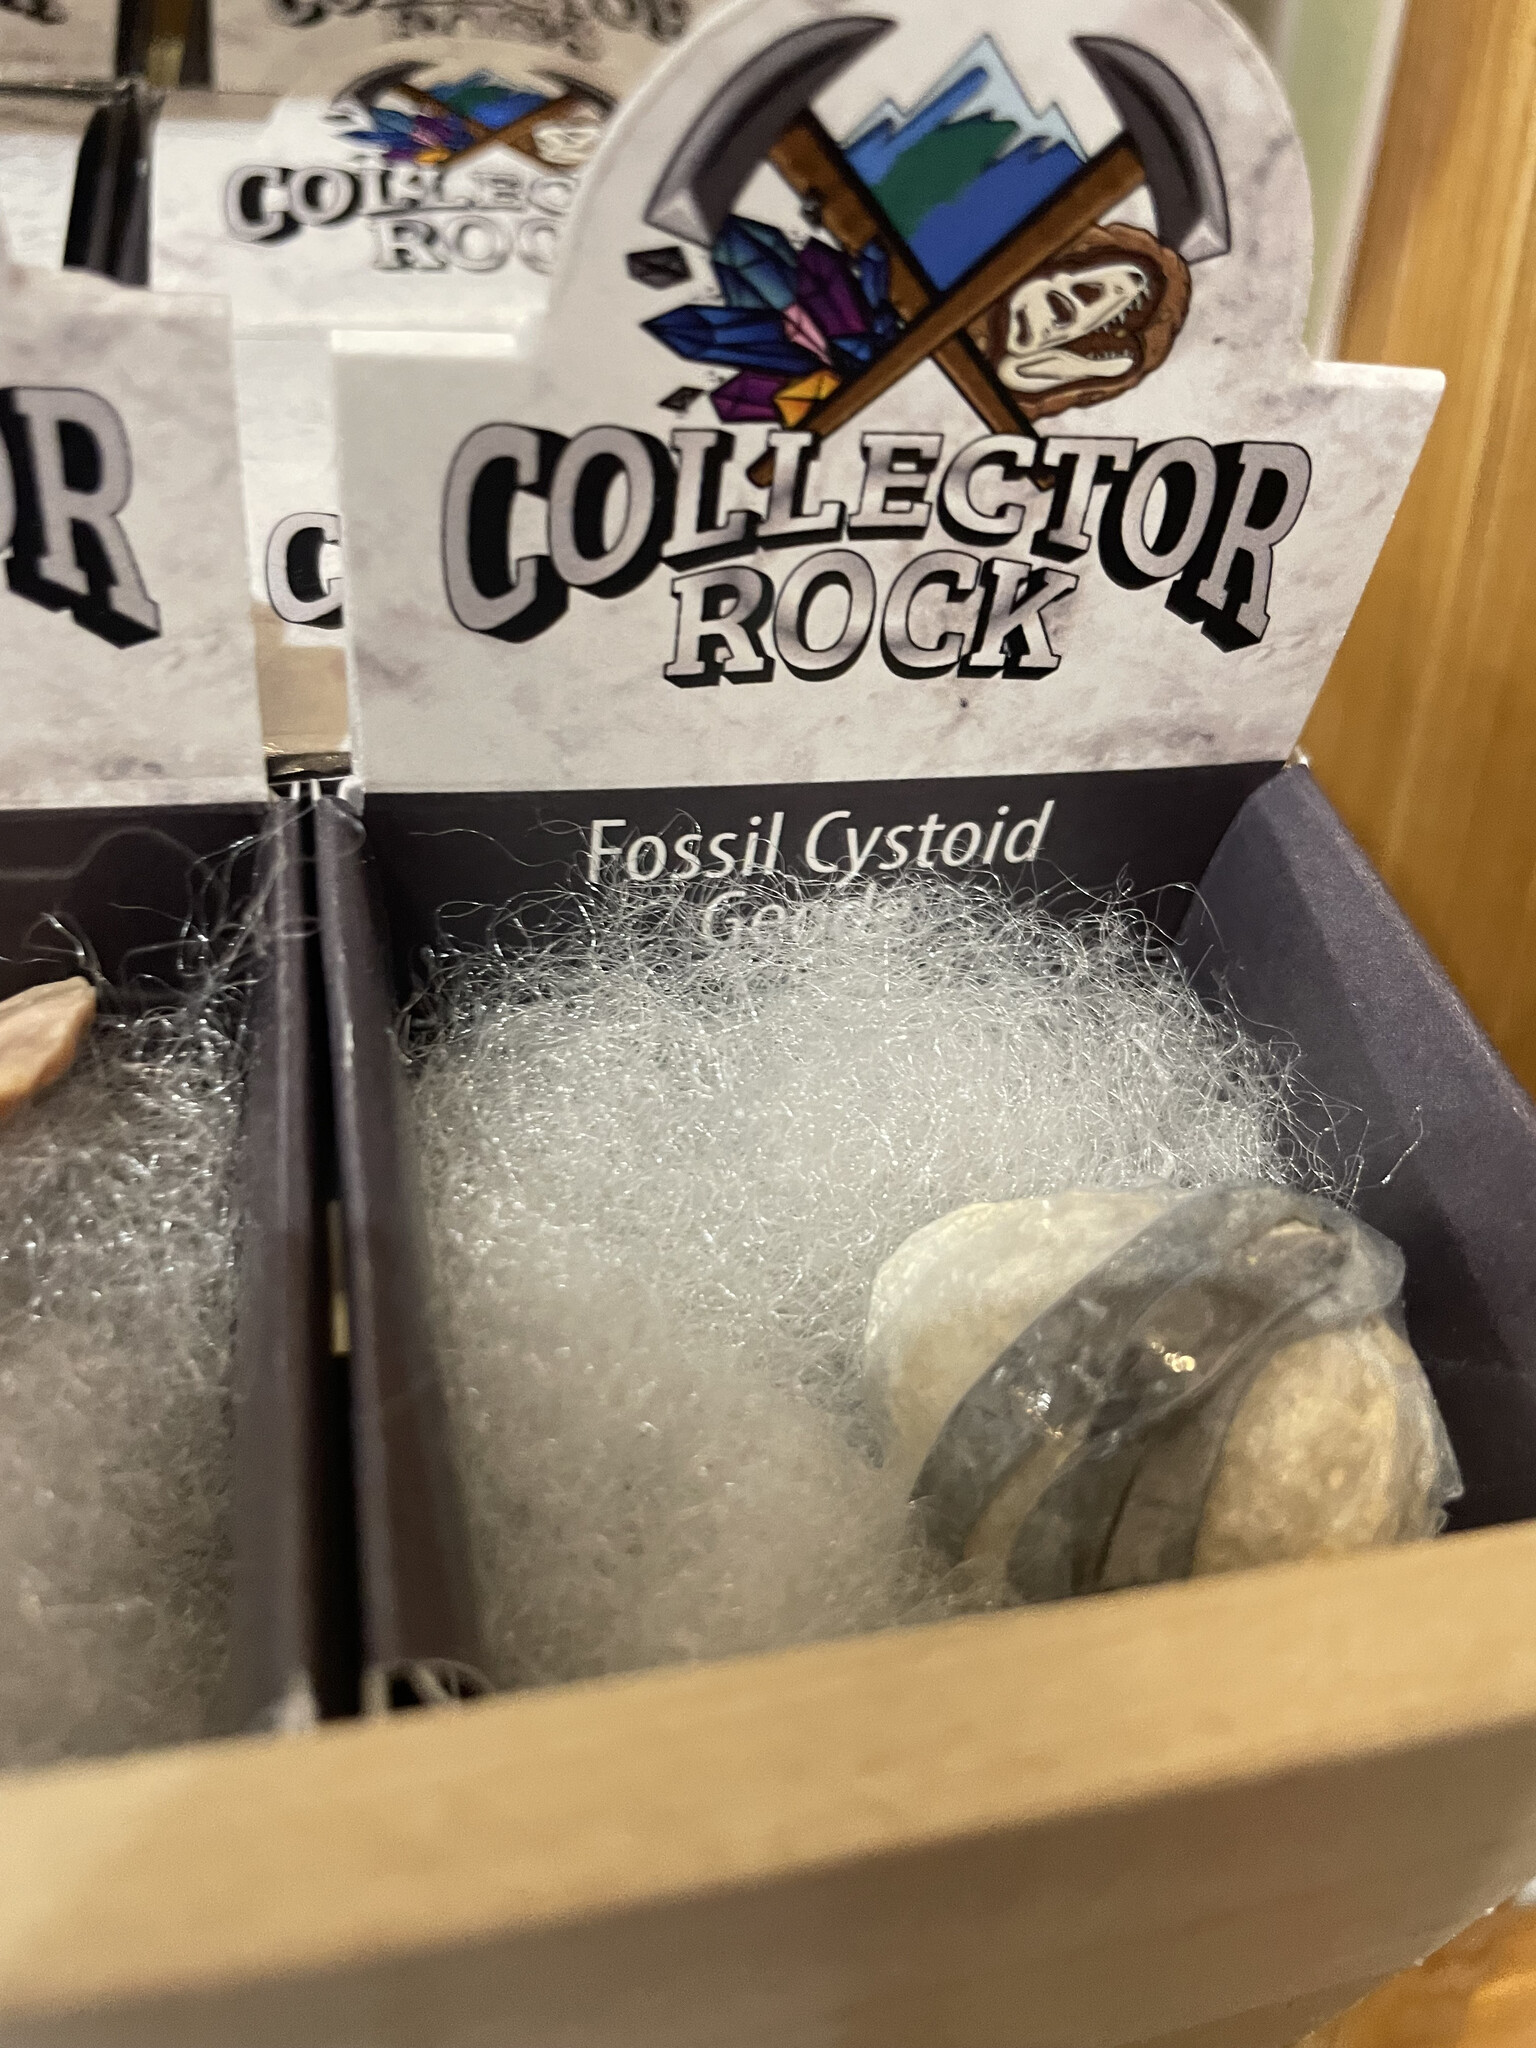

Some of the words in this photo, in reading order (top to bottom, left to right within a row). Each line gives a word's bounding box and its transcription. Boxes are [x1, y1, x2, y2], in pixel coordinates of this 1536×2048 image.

[0, 386, 162, 650] R
[441, 422, 1312, 652] COLLECTOR
[663, 549, 1078, 686] ROCK
[588, 812, 784, 883] Fossil
[805, 800, 1054, 889] Cystoid
